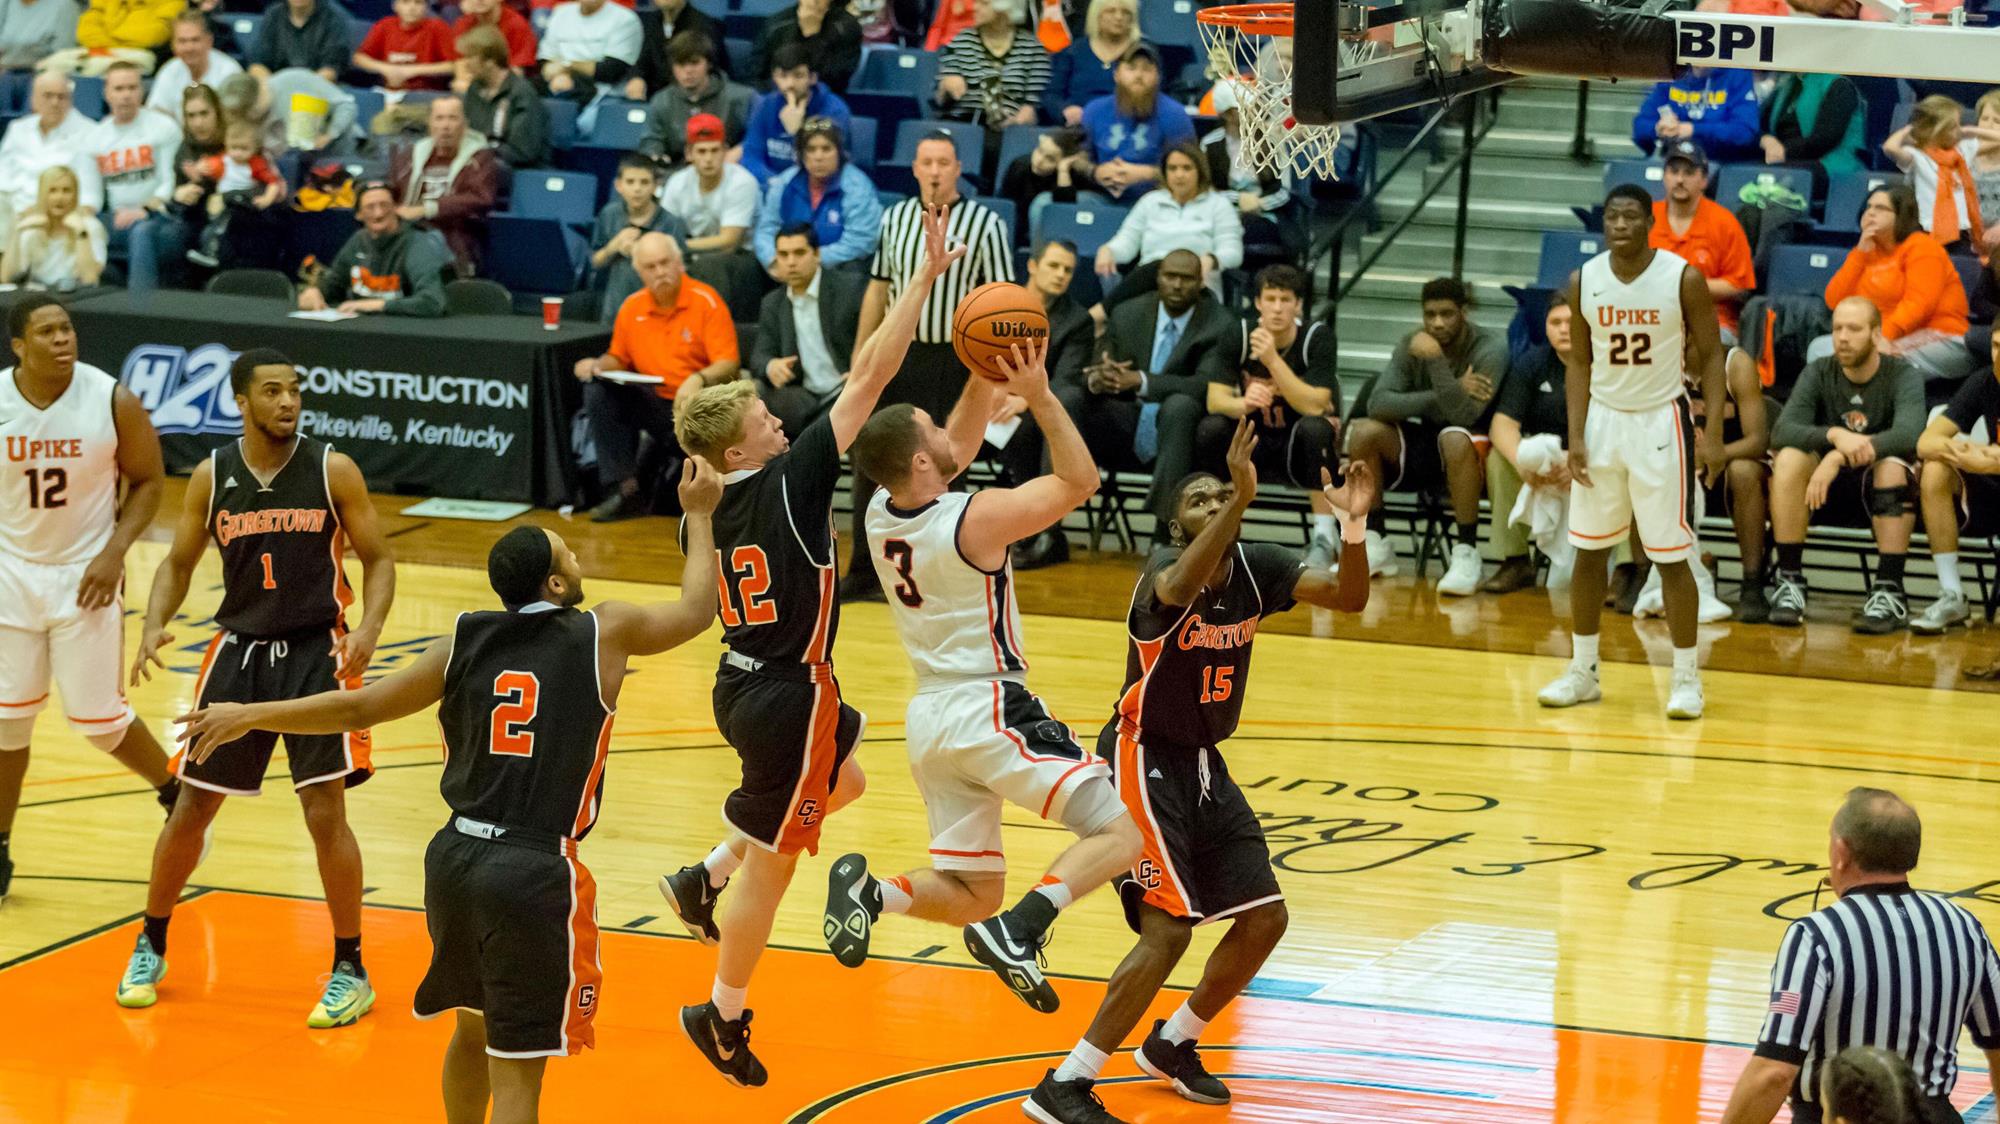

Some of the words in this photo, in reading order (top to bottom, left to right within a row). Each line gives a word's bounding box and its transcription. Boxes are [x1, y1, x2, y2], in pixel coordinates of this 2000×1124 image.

[1679, 21, 1774, 62] BPI
[991, 320, 1047, 338] Wilson
[1609, 332, 1652, 366] 22
[294, 364, 529, 410] CONSTRUCTION
[298, 408, 398, 446] Pikeville,
[404, 417, 515, 457] Kentucky
[23, 467, 68, 509] 12
[216, 508, 328, 547] GEORGETOWN
[261, 552, 277, 590] 1
[715, 544, 778, 626] 12
[883, 538, 924, 609] 3
[1200, 665, 1235, 704] 15
[489, 669, 540, 757] 2
[1239, 775, 1500, 813] Cour
